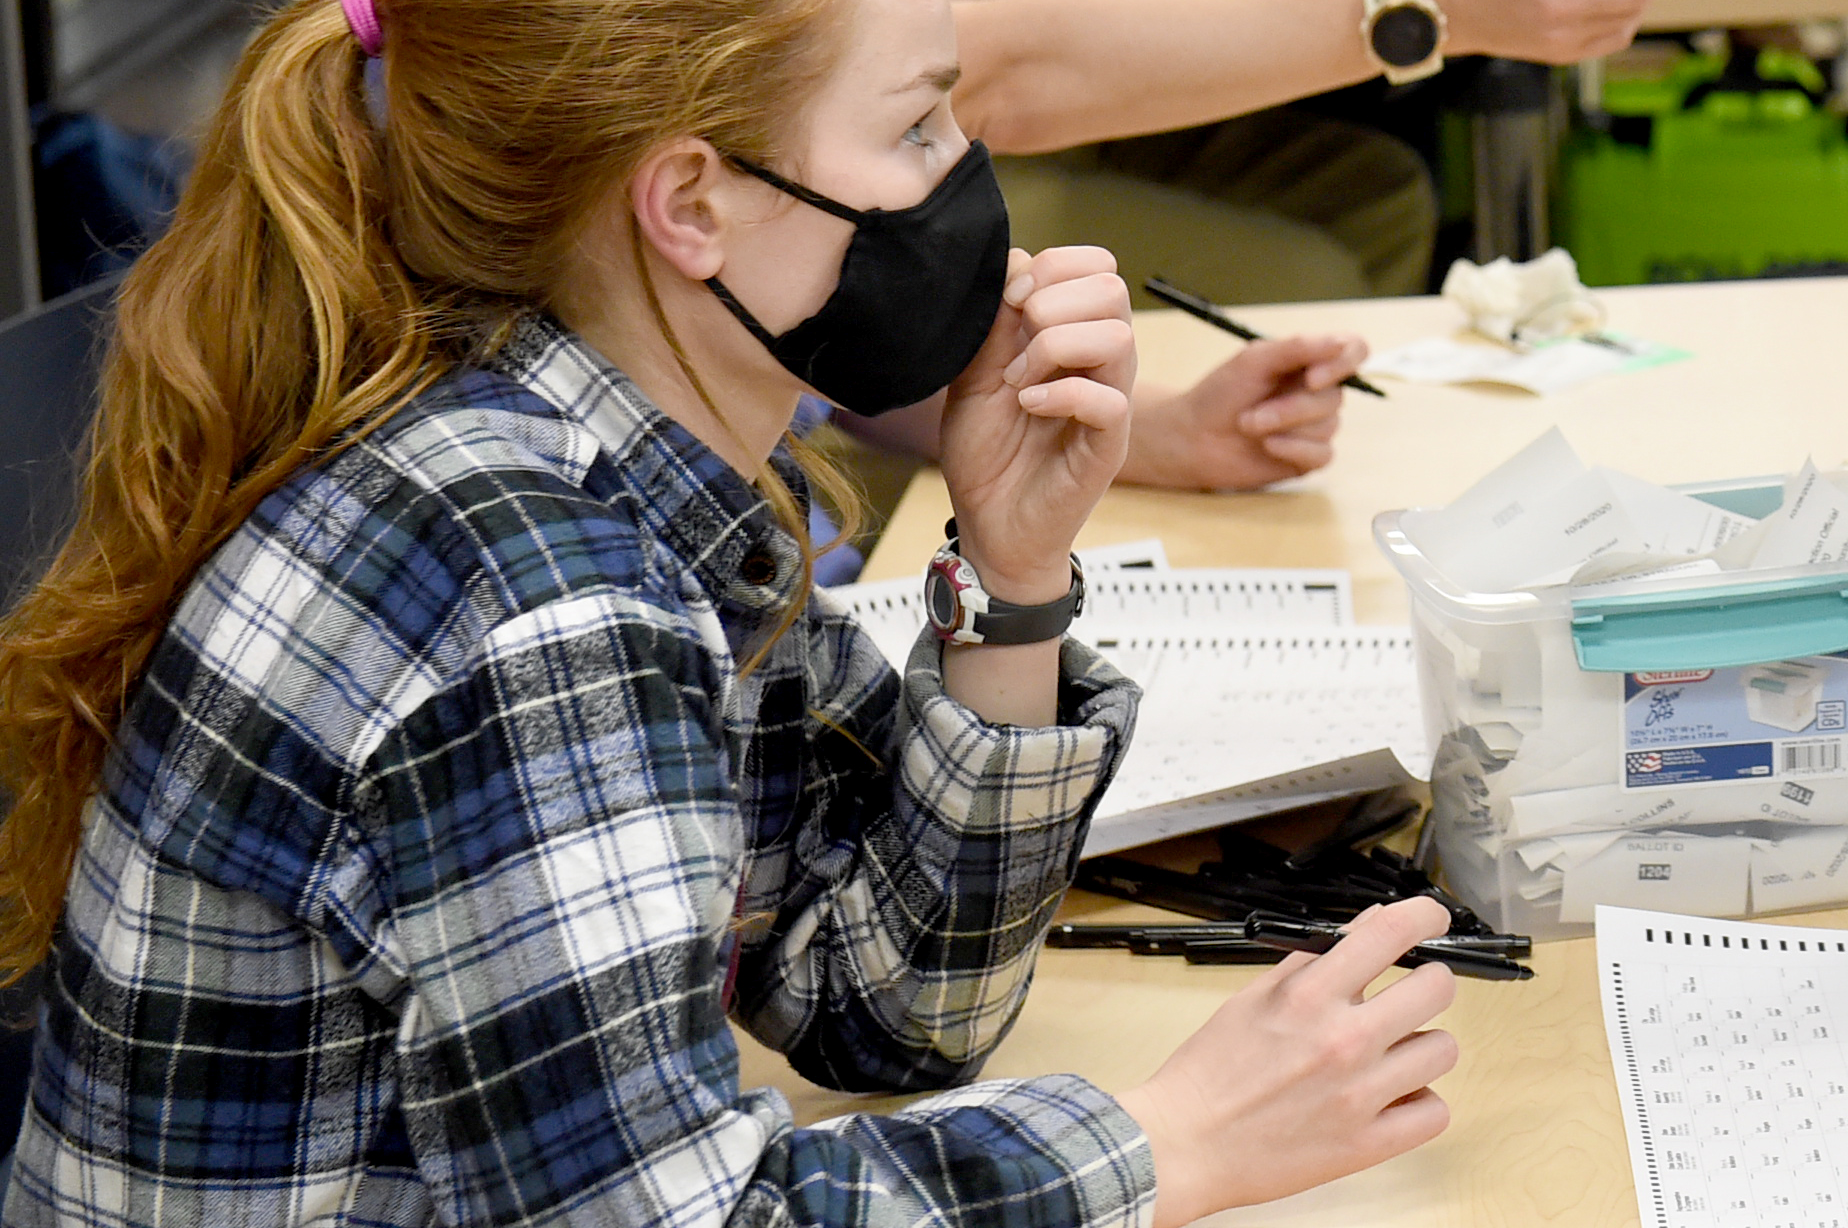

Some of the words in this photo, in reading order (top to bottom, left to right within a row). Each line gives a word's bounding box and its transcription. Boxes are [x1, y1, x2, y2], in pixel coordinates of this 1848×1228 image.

[1627, 842, 1669, 852] BALLOT
[1672, 843, 1685, 852] ID
[1639, 864, 1671, 880] 1204
